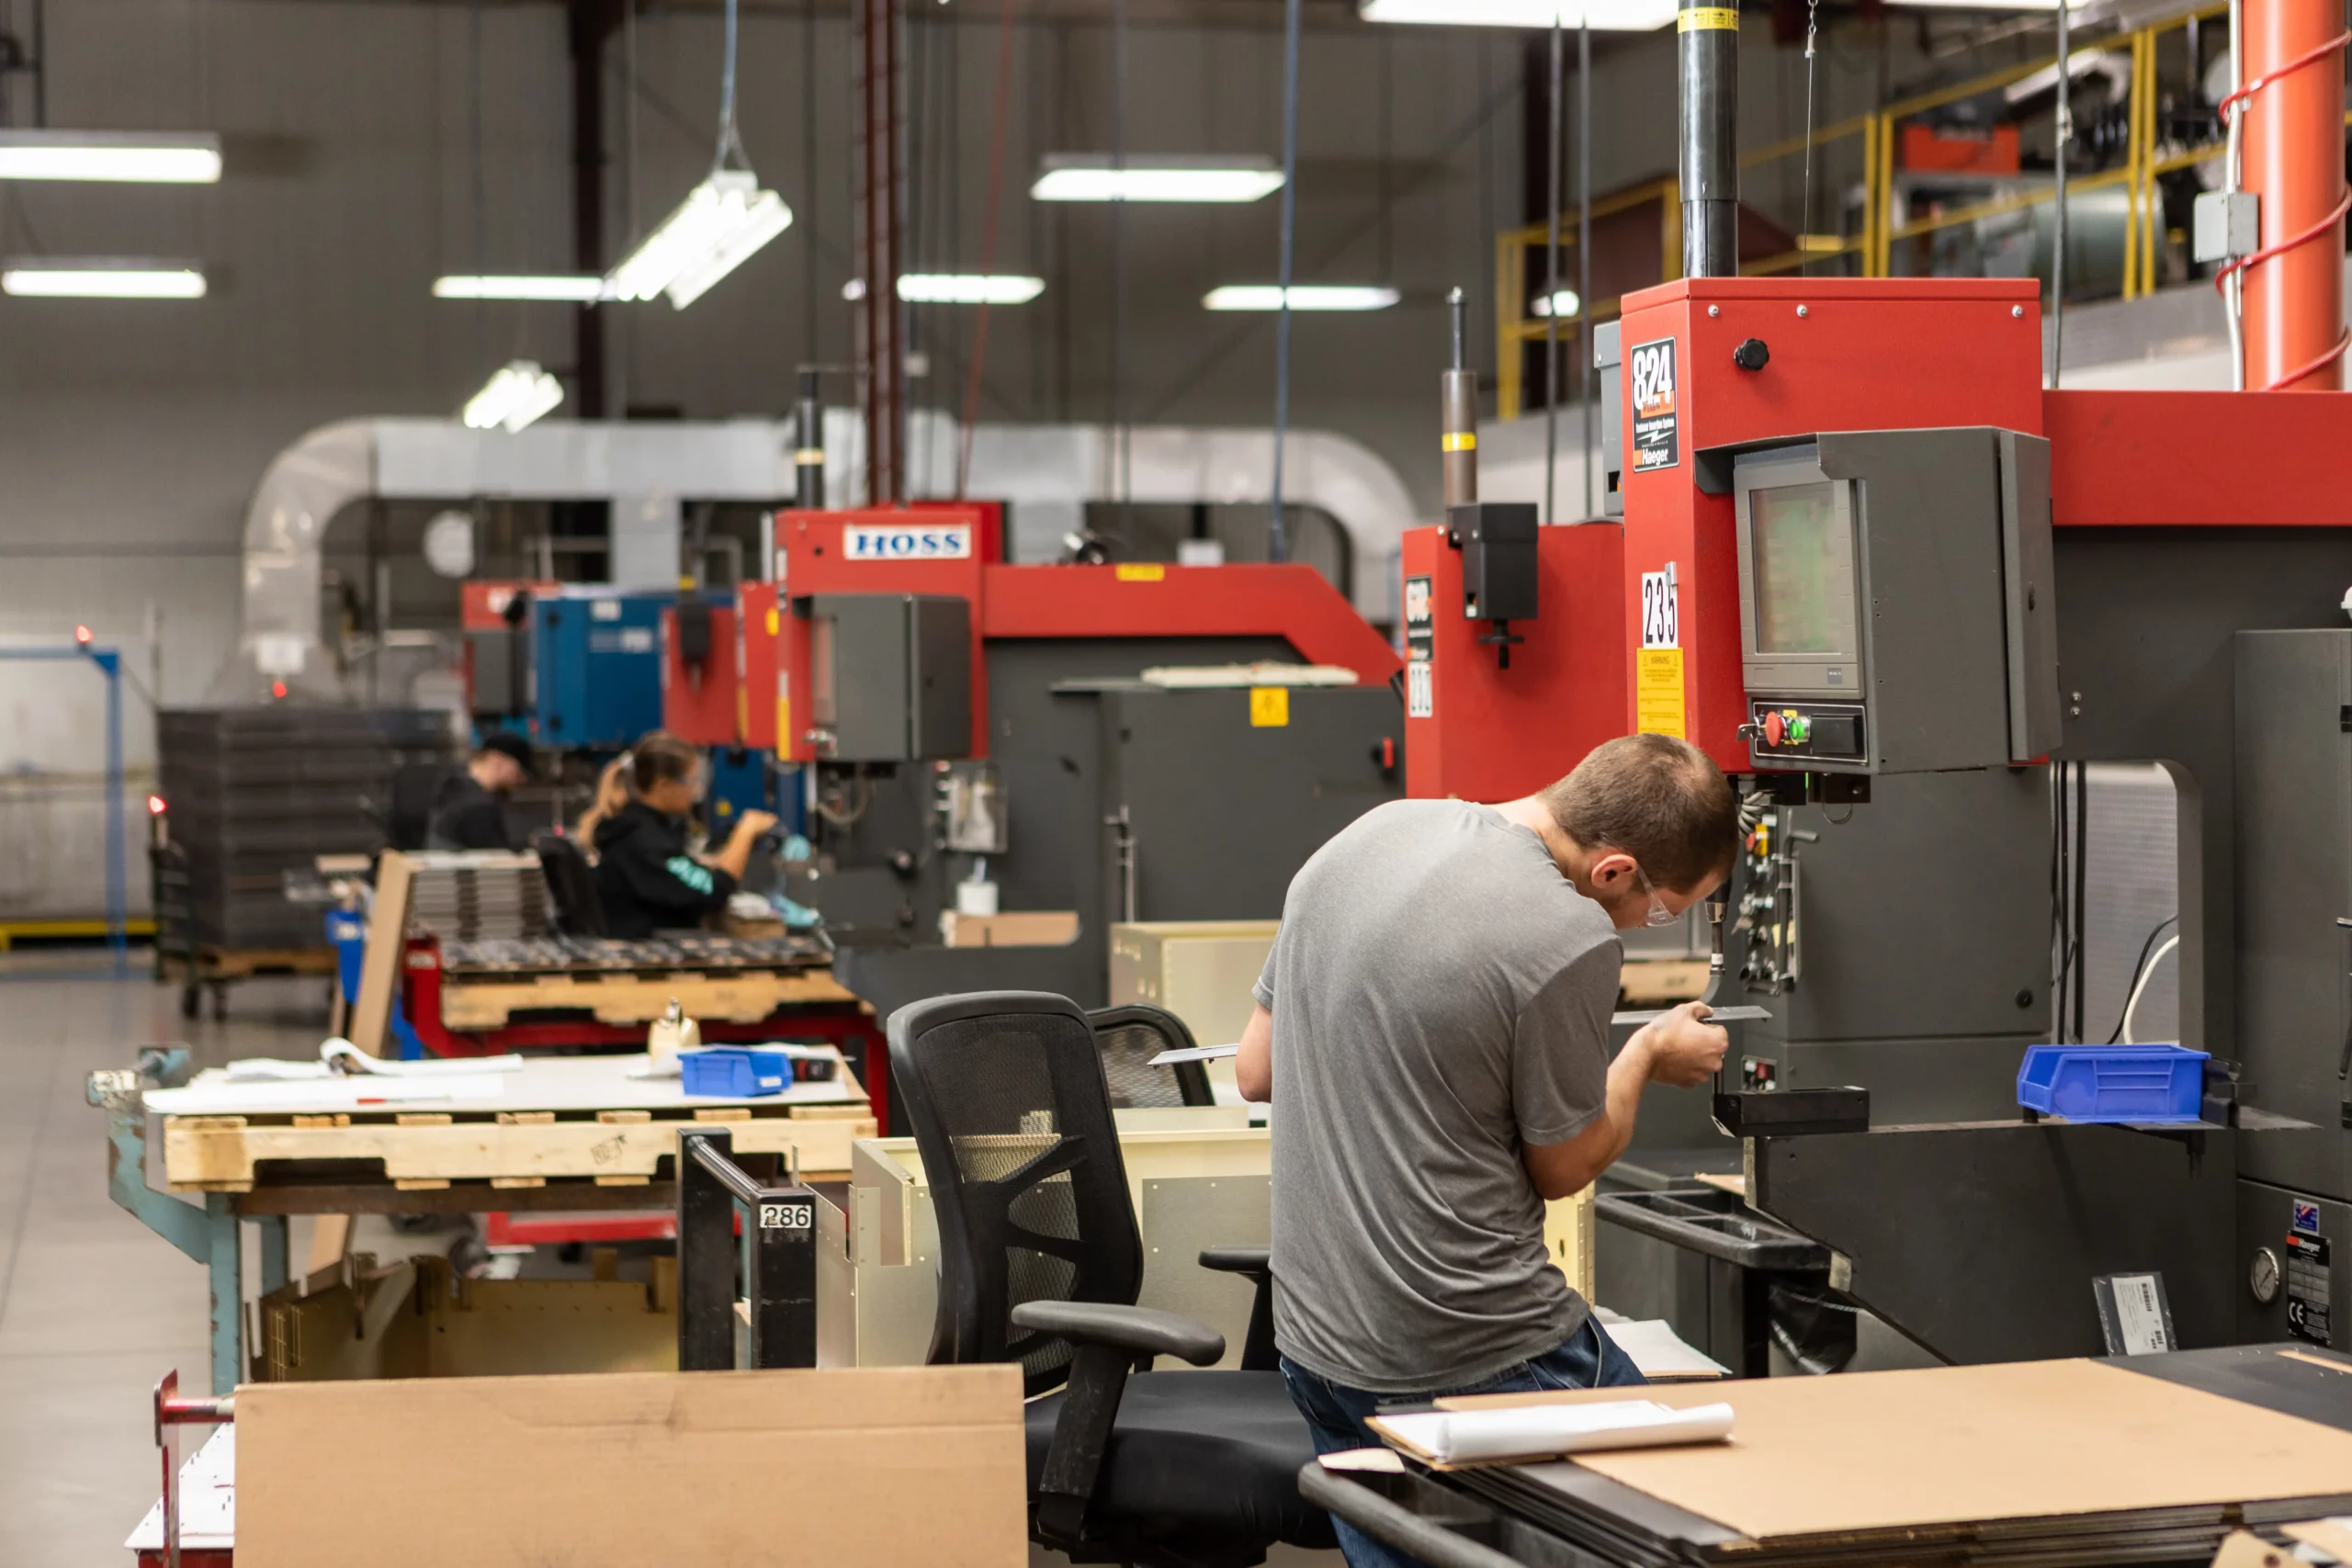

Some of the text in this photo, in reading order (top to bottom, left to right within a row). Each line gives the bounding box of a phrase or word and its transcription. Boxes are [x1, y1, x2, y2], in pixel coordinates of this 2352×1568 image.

[1633, 344, 1672, 411] 824
[1642, 447, 1668, 466] Haeger
[856, 534, 962, 556] HOSS
[1645, 577, 1675, 643] 235
[764, 1207, 809, 1227] 286
[2299, 1237, 2321, 1253] Haeger
